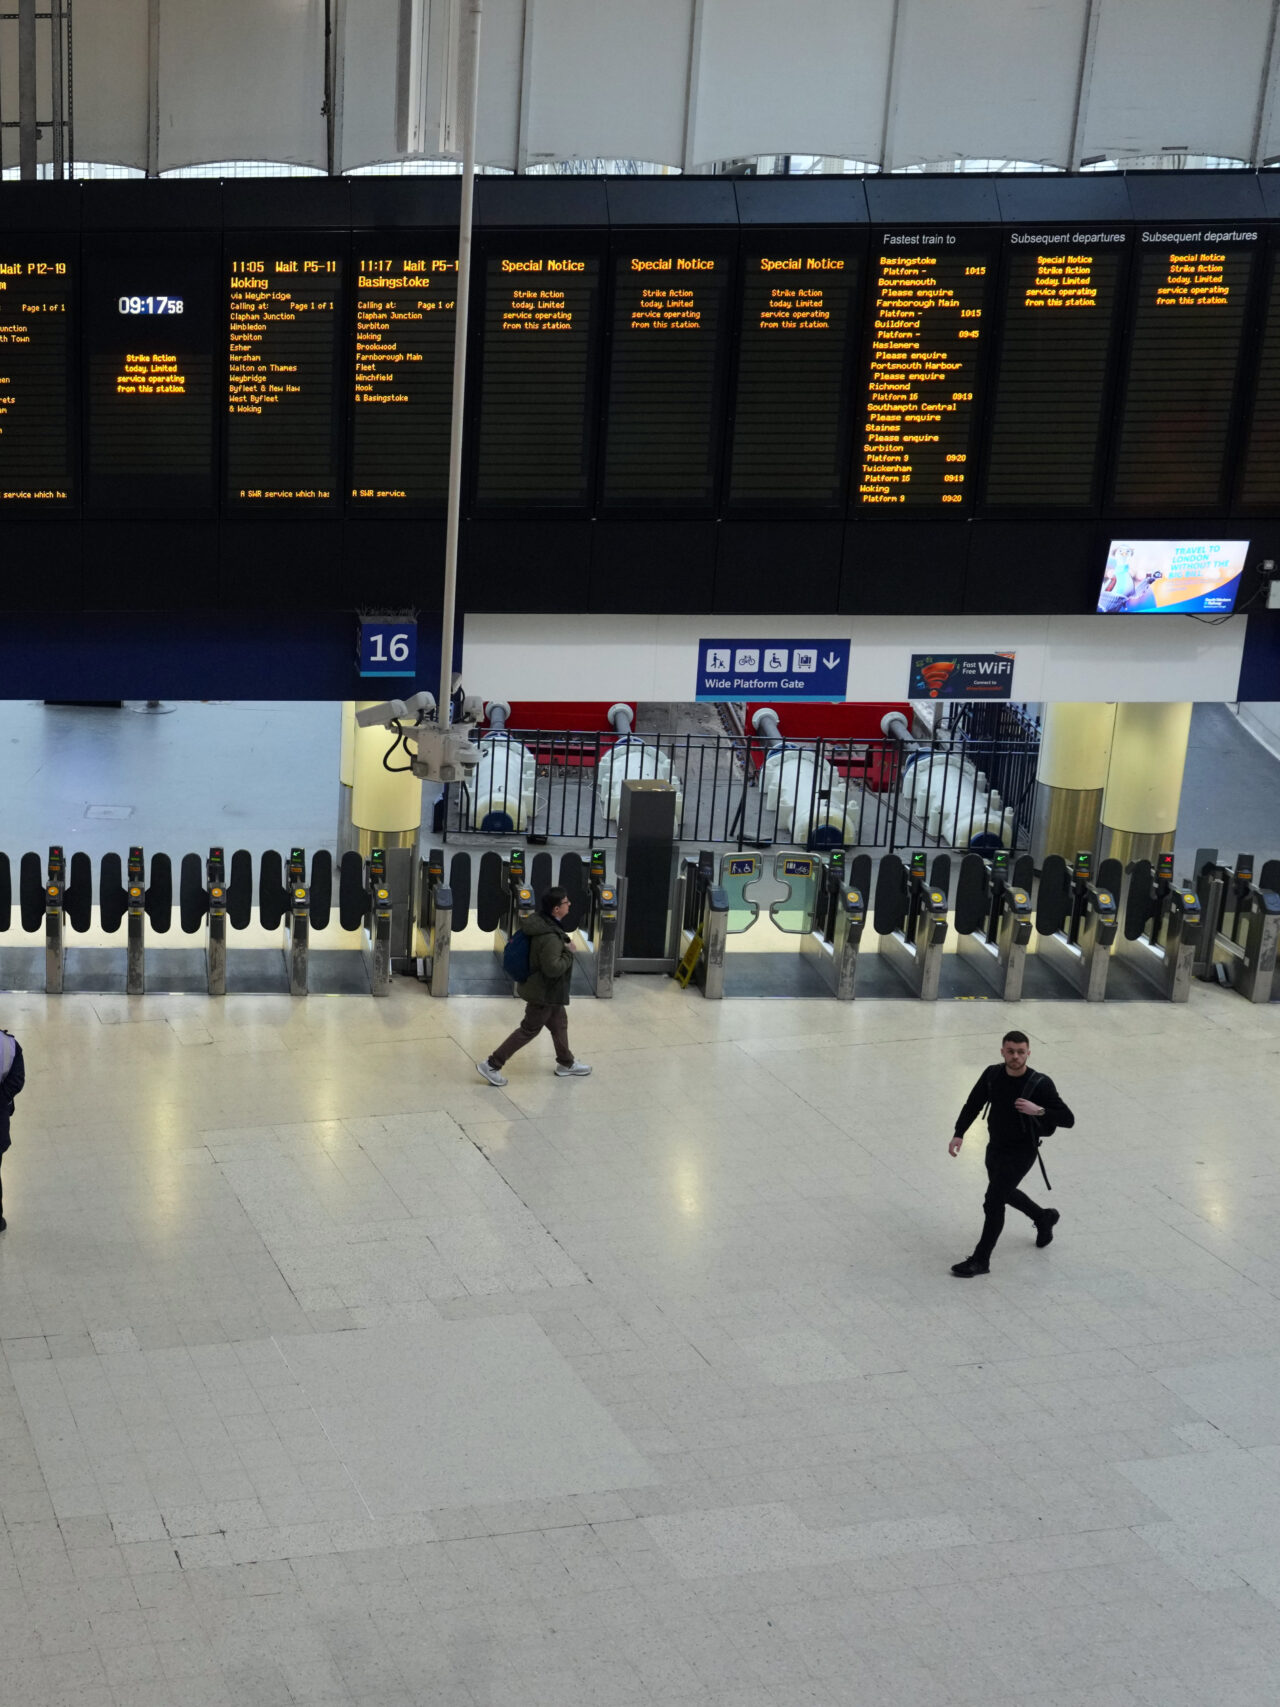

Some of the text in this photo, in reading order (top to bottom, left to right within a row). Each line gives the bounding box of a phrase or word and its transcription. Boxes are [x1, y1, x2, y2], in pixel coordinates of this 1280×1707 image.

[884, 234, 955, 244] Fastest train to
[1011, 233, 1125, 245] Subsequent departures
[1142, 231, 1257, 243] Subsequent departures
[761, 259, 844, 270] Special Notice
[880, 257, 936, 266] Basingstoke
[1038, 255, 1092, 264] Special Notice
[0, 264, 22, 274] Wait
[28, 263, 65, 274] P12-19
[233, 261, 335, 272] 11:05 Wait P5-11
[360, 261, 392, 272] 11:17
[404, 261, 427, 272] Wait
[502, 260, 584, 272] Special Notice
[632, 259, 714, 271] Special Notice
[883, 267, 918, 275] Platform
[231, 278, 268, 289] Woking
[359, 276, 429, 288] Basingstoke
[878, 277, 936, 286] Bournemouth
[245, 292, 291, 301] Weybridge
[882, 288, 953, 297] Please enquire
[877, 298, 959, 308] Farnborough Main
[875, 319, 920, 328] Guildford
[873, 340, 919, 349] Haslemere
[127, 354, 176, 362] Strike Action
[125, 364, 177, 374] today. Limited
[871, 361, 962, 369] Portsmouth Harbour
[118, 375, 184, 384] service operating
[138, 384, 153, 392] this
[156, 384, 184, 392] station.
[869, 382, 910, 390] Richmond
[872, 392, 907, 400] Platform
[1175, 545, 1221, 555] TRAVEL TO
[1172, 554, 1209, 564] LONDON
[1170, 561, 1211, 571] WITHOUT
[1168, 571, 1184, 579] BIG
[369, 633, 409, 662] 16
[977, 661, 1012, 675] WiFi
[705, 678, 805, 689] Wide Platform Gate
